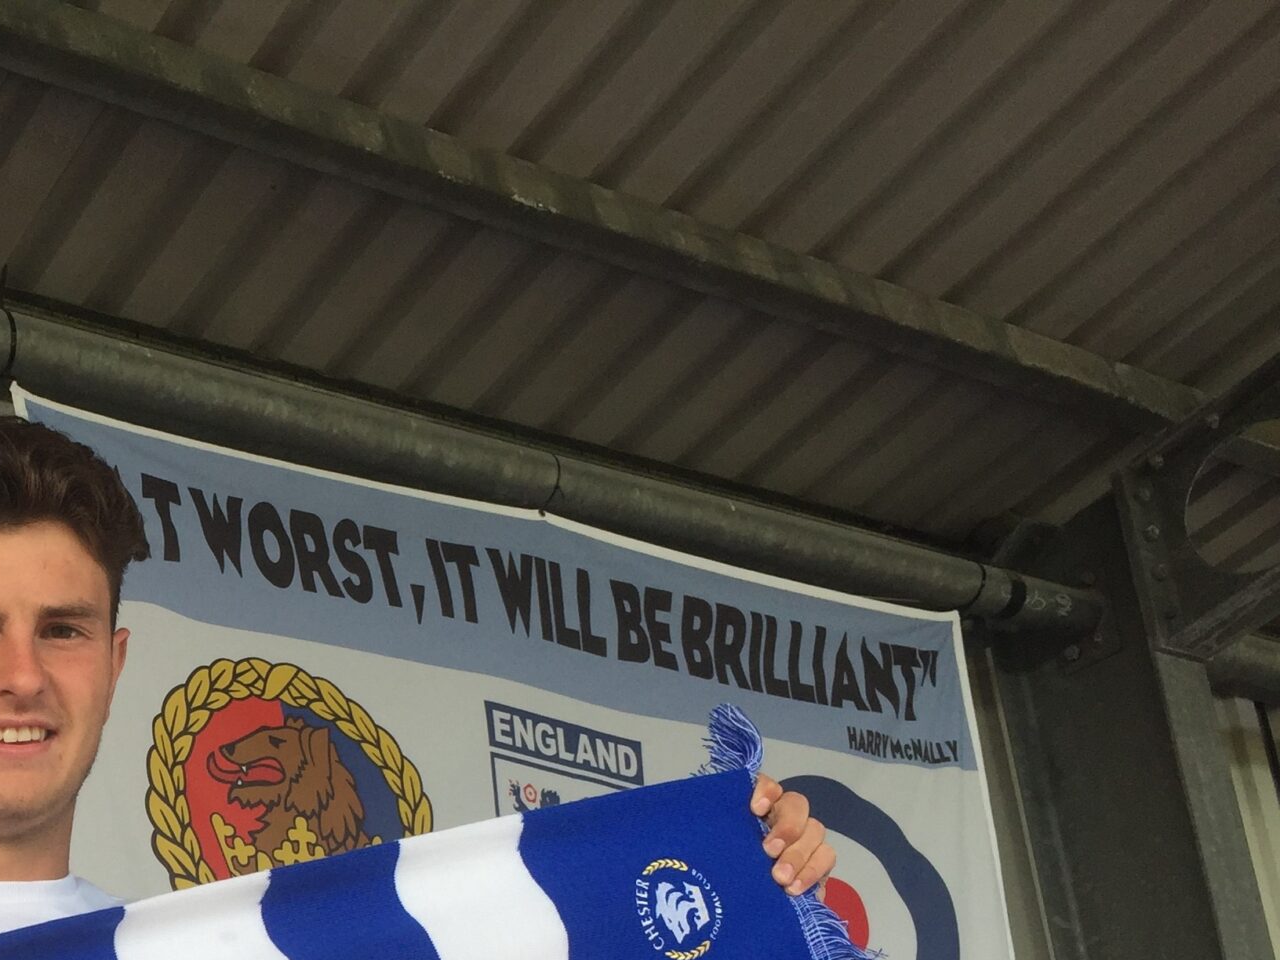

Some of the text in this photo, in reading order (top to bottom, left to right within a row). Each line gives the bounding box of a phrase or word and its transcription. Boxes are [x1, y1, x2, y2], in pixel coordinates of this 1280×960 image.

[187, 486, 425, 625] WORST,
[425, 538, 480, 624] IT
[485, 547, 607, 658] WILL
[609, 578, 679, 671] BE
[492, 709, 638, 778] ENGLAND
[846, 725, 890, 758] HARRY
[635, 878, 665, 950] CHESTER
